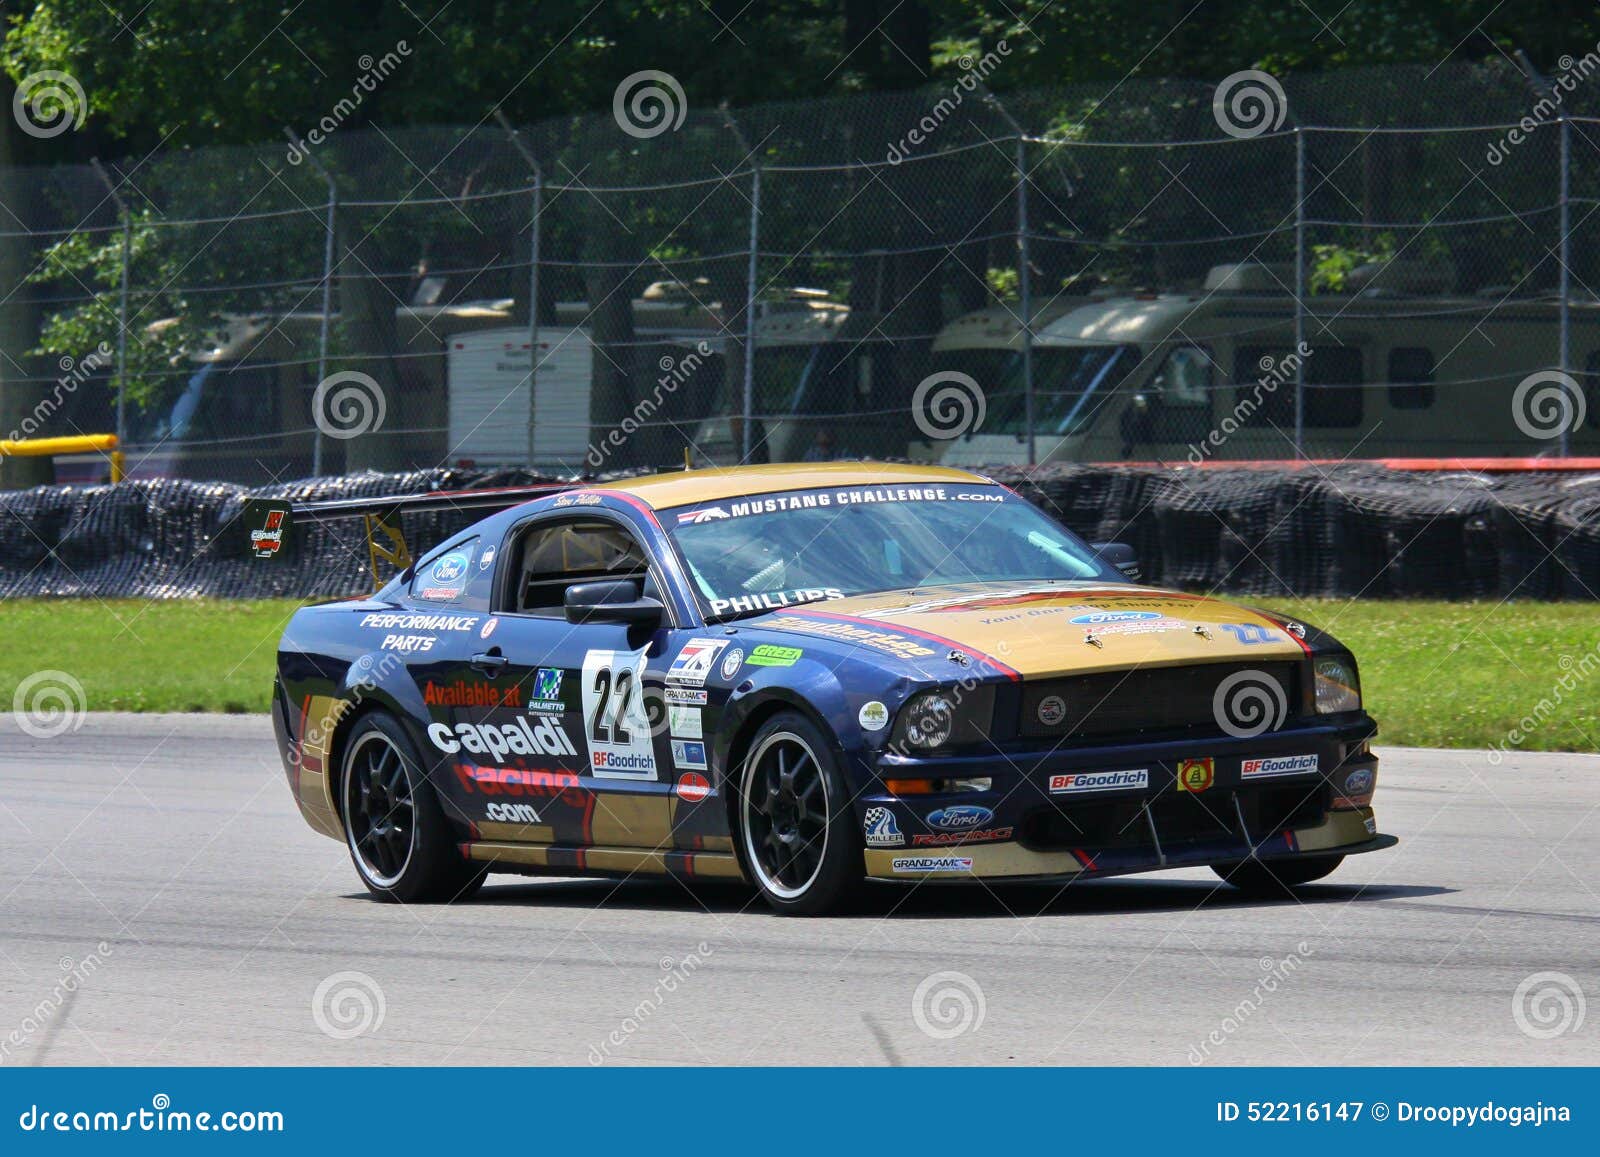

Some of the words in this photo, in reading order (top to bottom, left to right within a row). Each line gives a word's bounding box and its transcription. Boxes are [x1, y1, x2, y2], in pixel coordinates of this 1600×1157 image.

[731, 494, 830, 517] MUSTANG
[836, 488, 947, 505] CHALLENGE
[710, 588, 845, 615] PHILLIPS
[360, 614, 479, 631] PERFORMANCE
[381, 635, 437, 651] PARTS
[752, 645, 803, 660] GREEN
[424, 680, 498, 706] Available
[504, 684, 520, 706] at
[528, 702, 565, 711] PALMETTO
[592, 666, 633, 746] 22
[427, 716, 578, 763] capaldi
[593, 752, 654, 769] BFGoodrich
[1243, 755, 1317, 773] BFGoodrich
[453, 760, 587, 808] racing
[1051, 769, 1149, 788] BFGoodrich
[486, 803, 542, 823] .com
[940, 808, 981, 826] Ford
[866, 833, 904, 842] MILLER
[912, 826, 1014, 845] RACING
